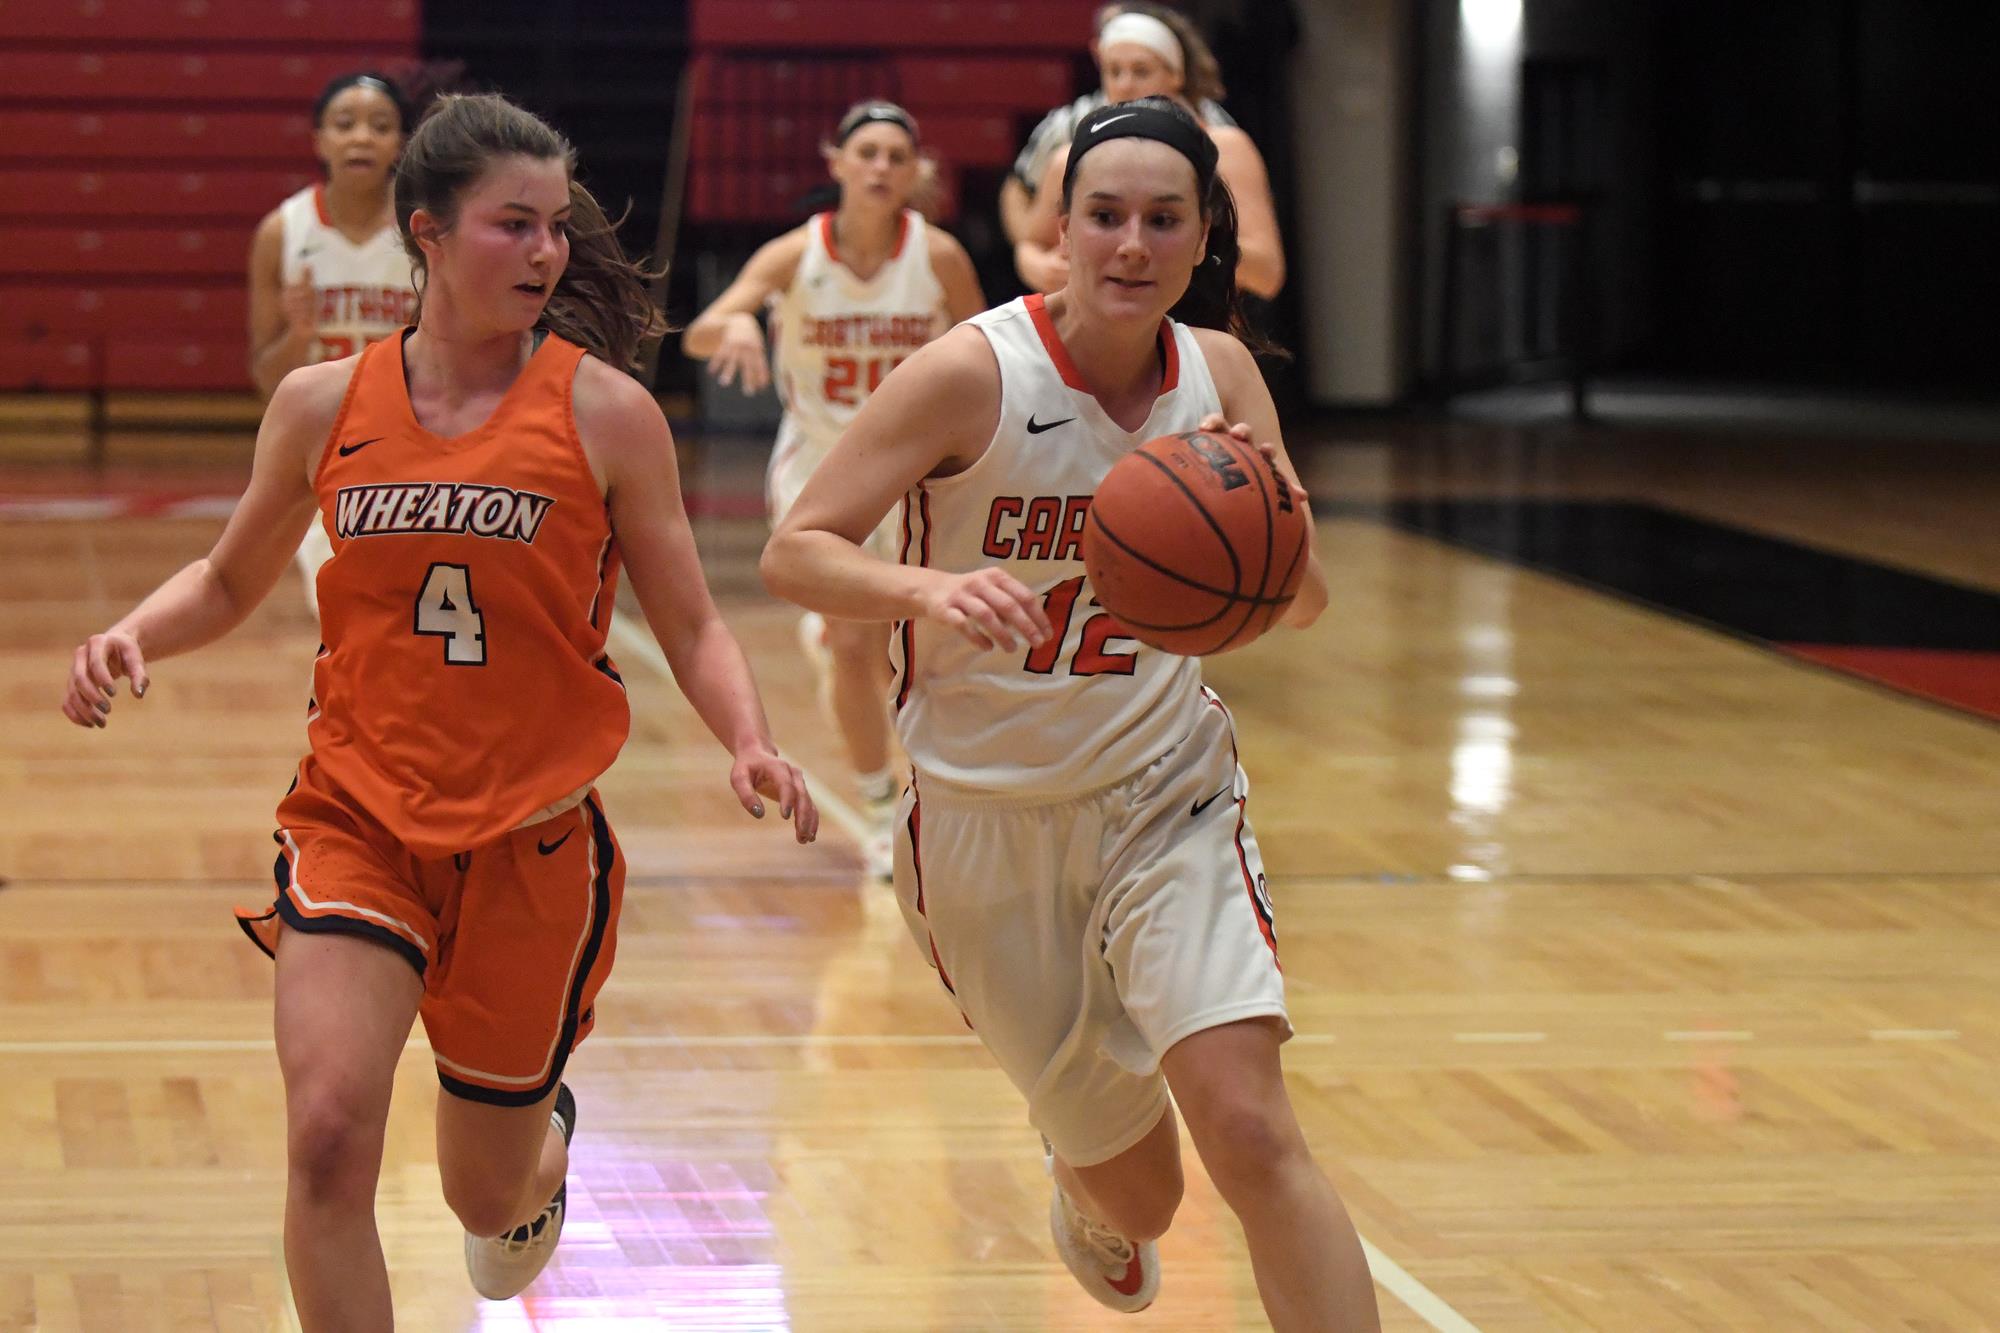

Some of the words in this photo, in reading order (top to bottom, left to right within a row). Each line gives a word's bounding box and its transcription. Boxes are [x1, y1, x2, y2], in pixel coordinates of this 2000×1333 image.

[335, 481, 557, 544] WHEATON
[413, 561, 487, 666] 4
[1023, 575, 1138, 676] 12
